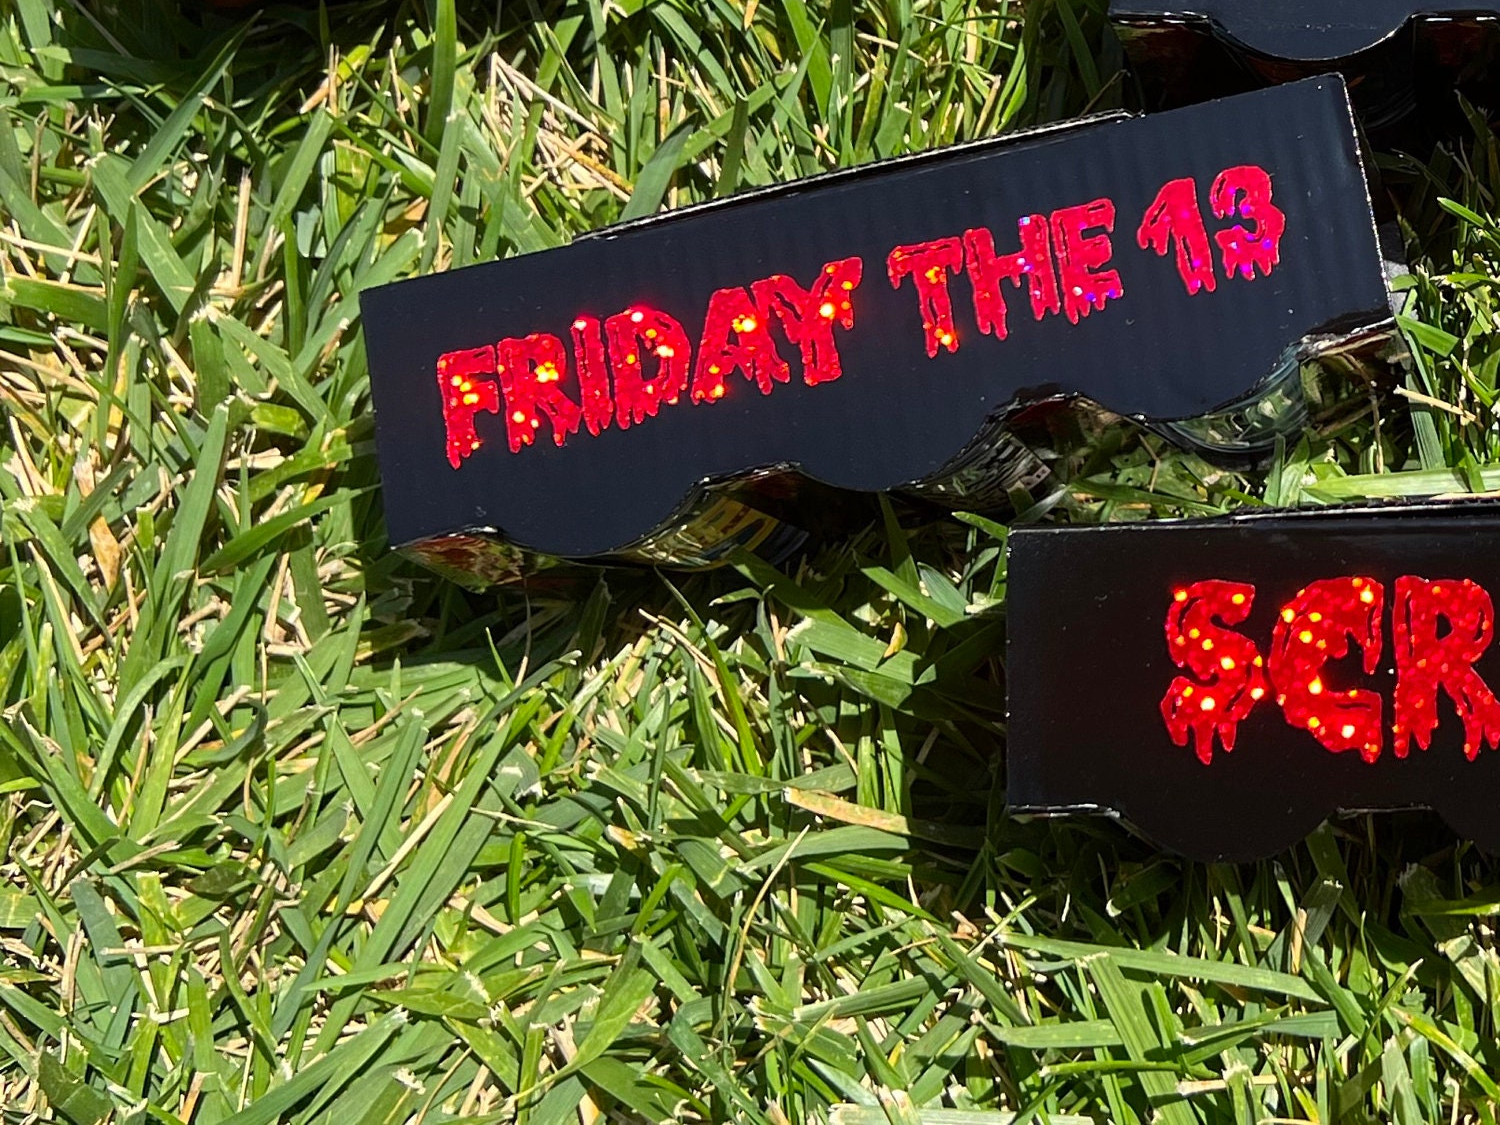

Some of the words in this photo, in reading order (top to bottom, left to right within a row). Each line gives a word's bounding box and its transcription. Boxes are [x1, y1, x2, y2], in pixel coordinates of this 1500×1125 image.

[438, 259, 861, 468] FRIDAY
[889, 200, 1121, 356] THE
[1139, 166, 1283, 295] 13
